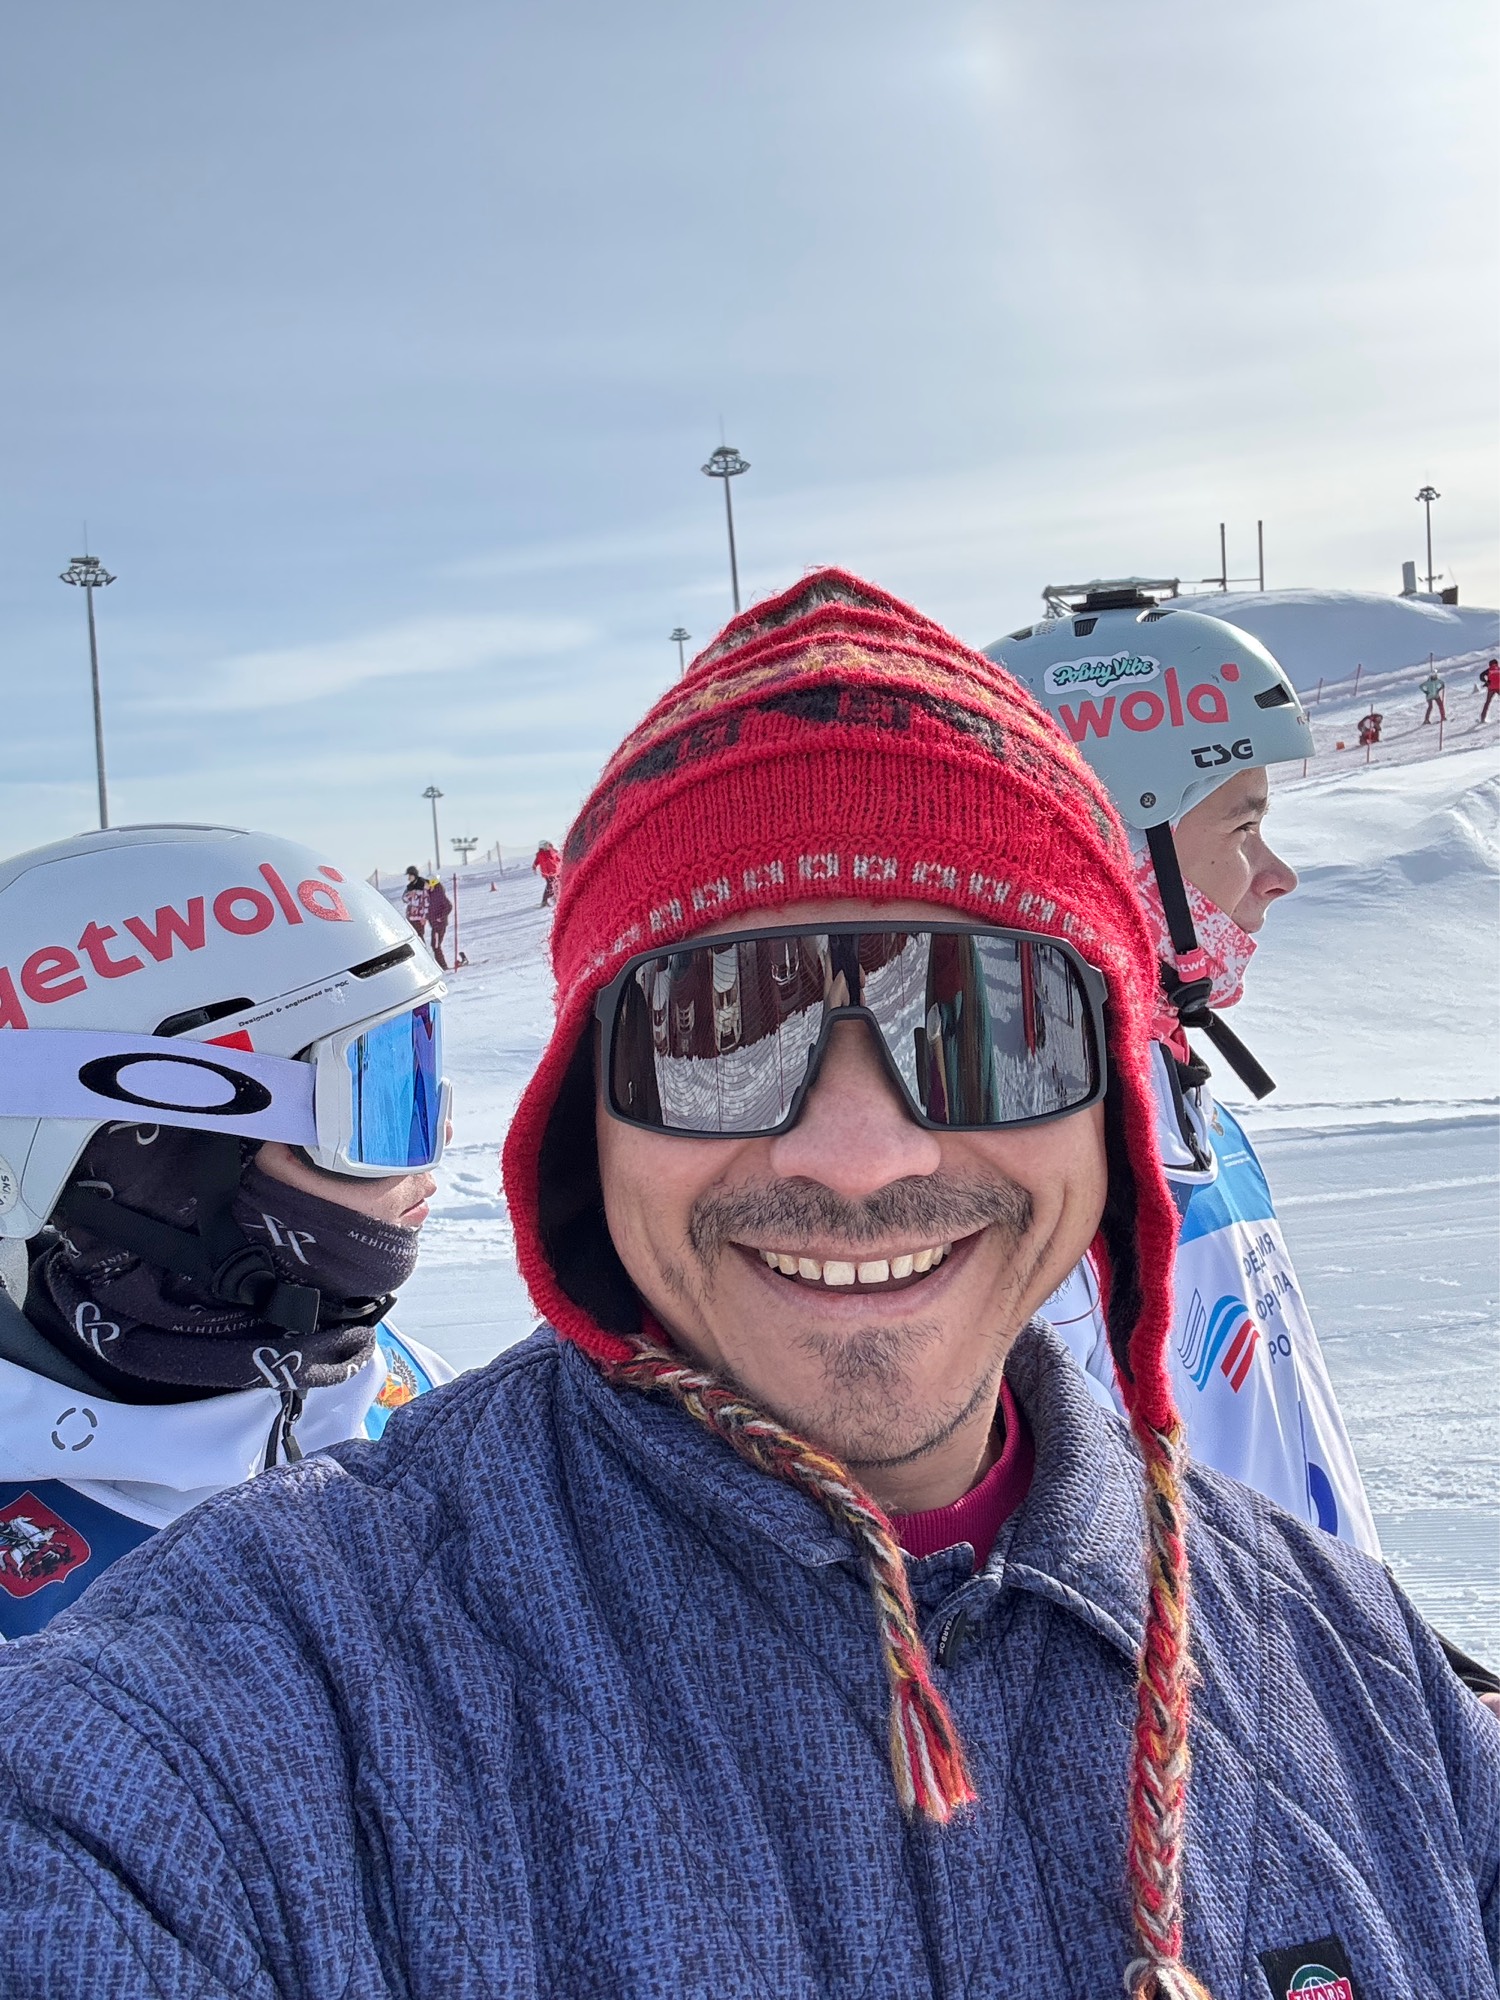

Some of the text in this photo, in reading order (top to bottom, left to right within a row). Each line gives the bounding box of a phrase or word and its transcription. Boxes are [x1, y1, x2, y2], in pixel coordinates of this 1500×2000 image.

[1191, 738, 1254, 769] TSG
[238, 1010, 274, 1028] Designed
[284, 990, 323, 1010] engineered
